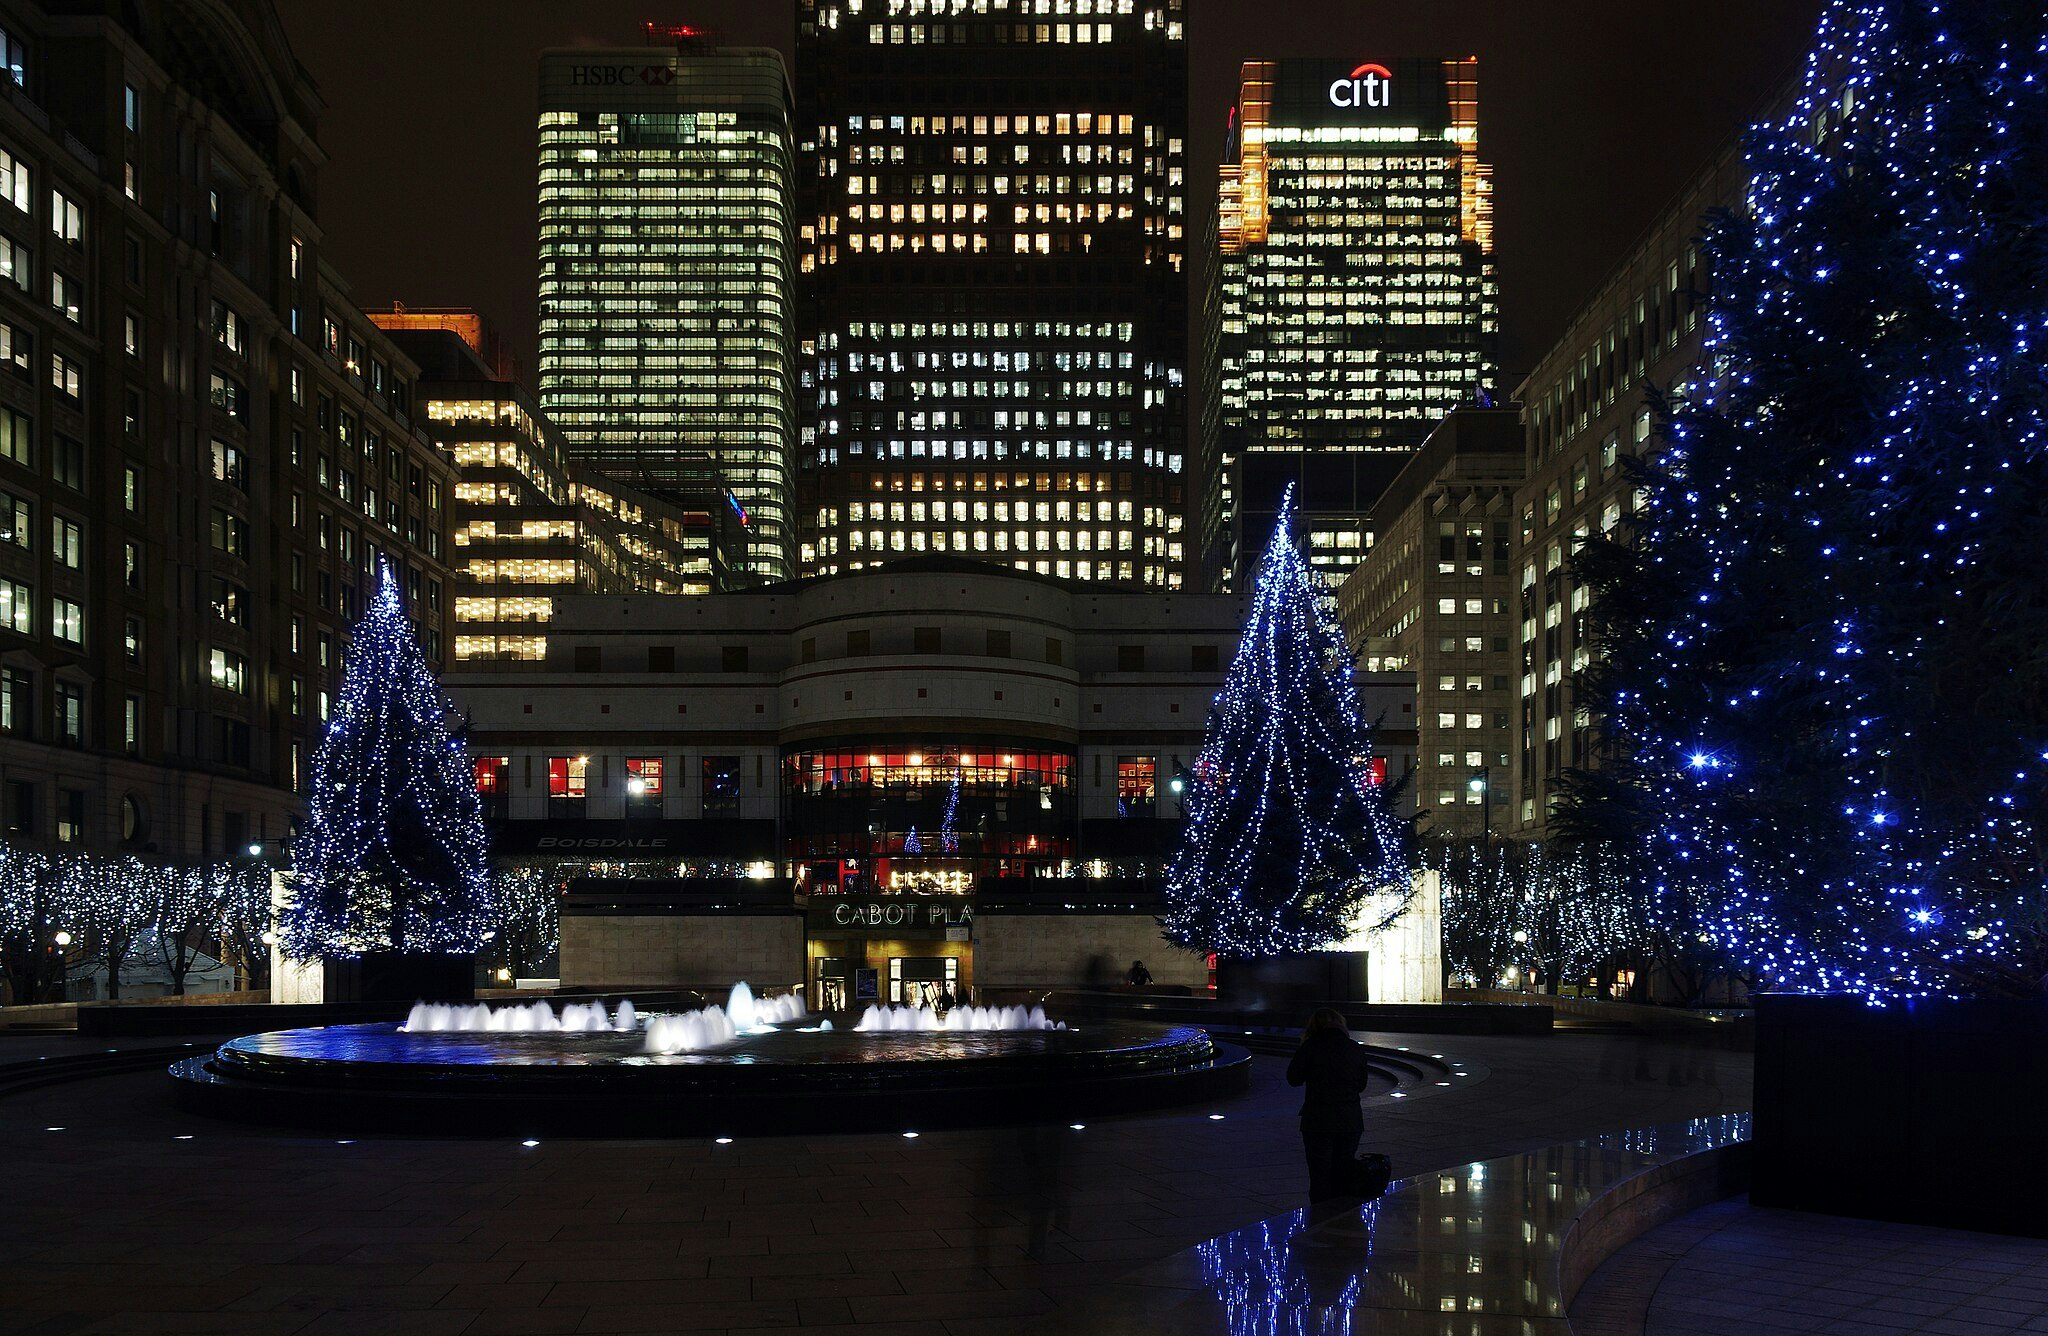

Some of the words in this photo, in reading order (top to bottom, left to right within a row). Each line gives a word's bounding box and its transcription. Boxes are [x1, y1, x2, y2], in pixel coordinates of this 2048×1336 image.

[571, 65, 635, 86] HSBC
[1329, 70, 1390, 108] citi
[537, 837, 668, 848] BOISDALE
[834, 903, 919, 925] CABOT
